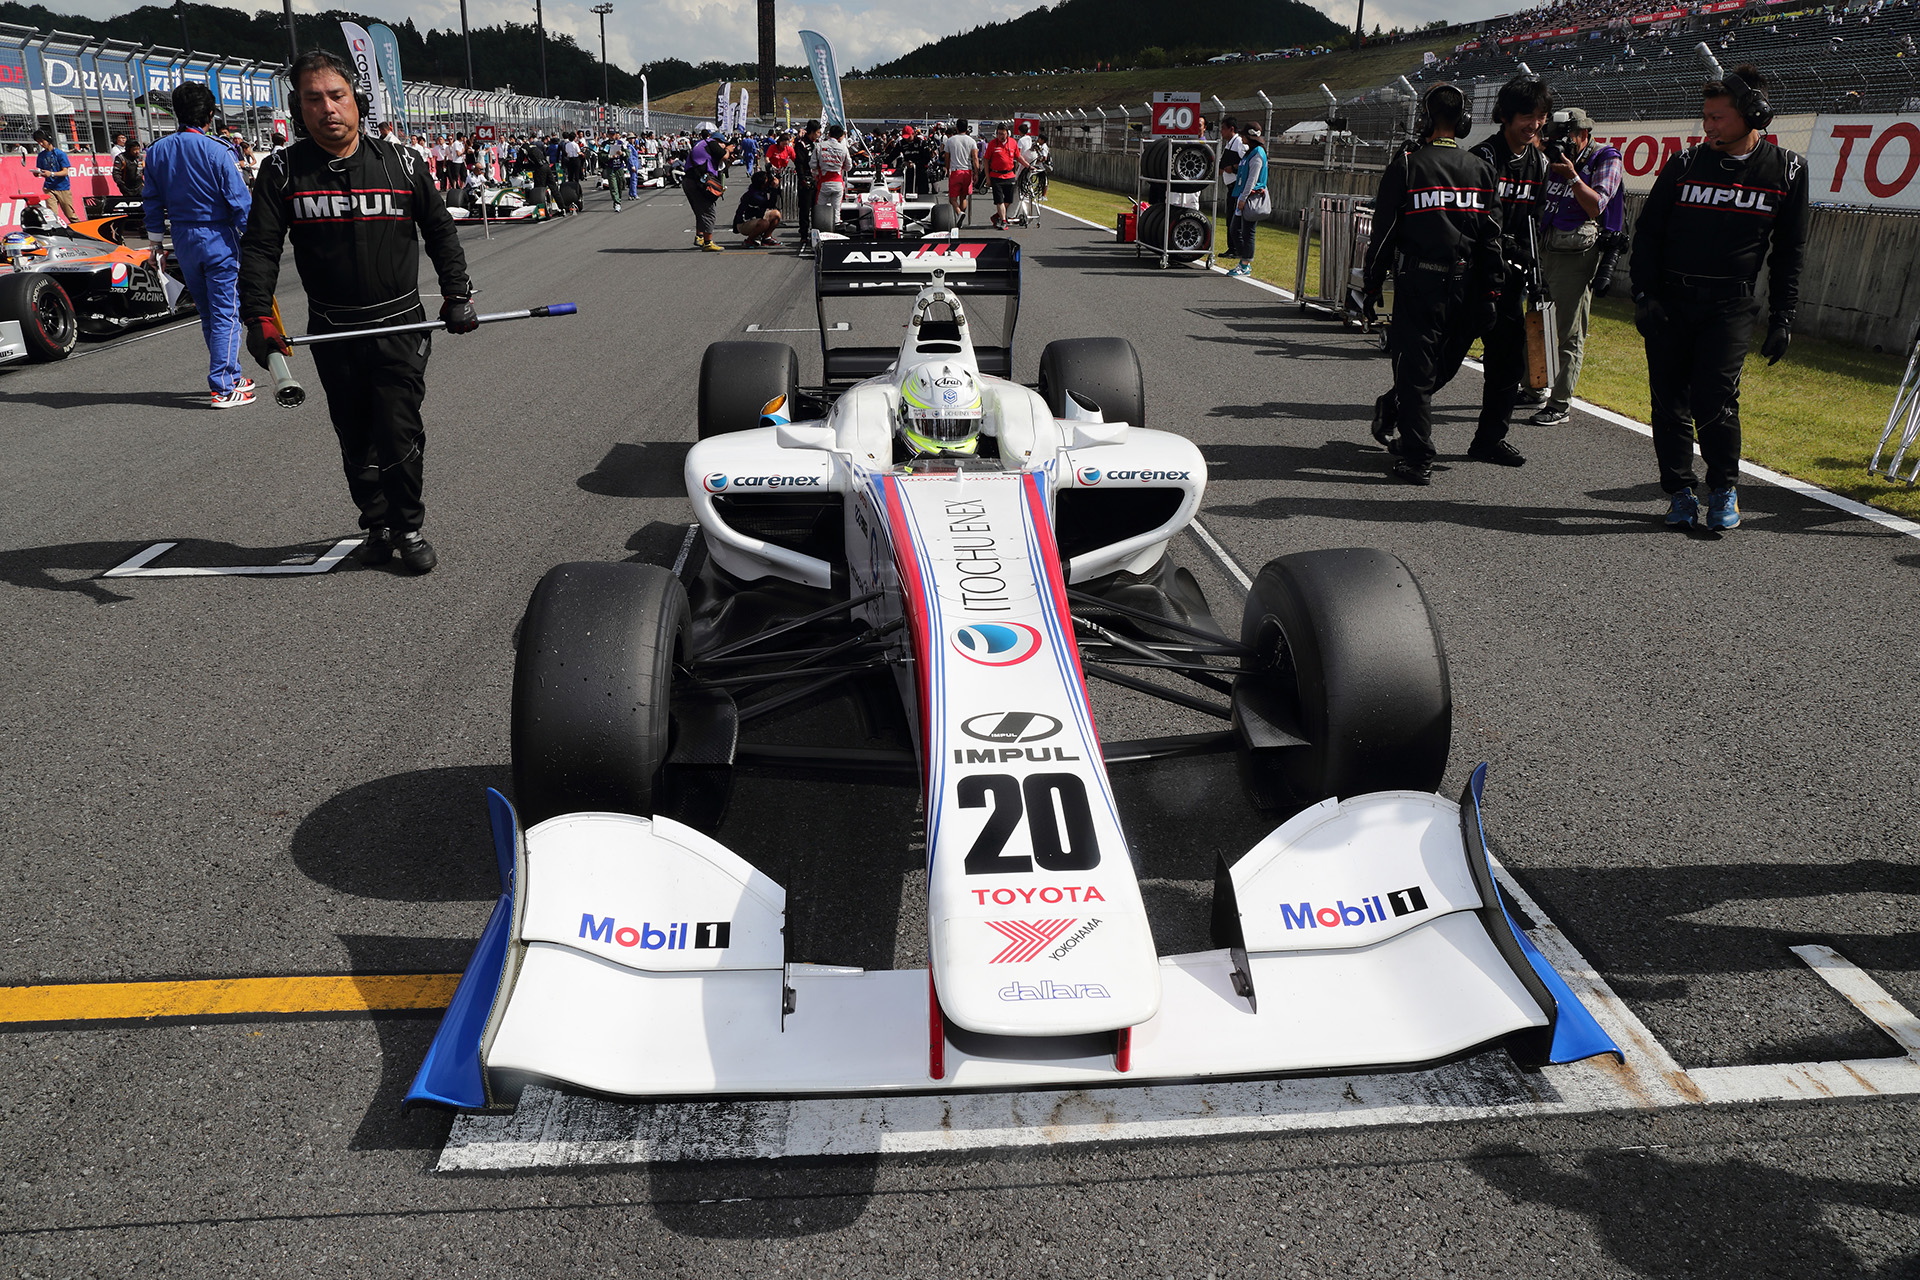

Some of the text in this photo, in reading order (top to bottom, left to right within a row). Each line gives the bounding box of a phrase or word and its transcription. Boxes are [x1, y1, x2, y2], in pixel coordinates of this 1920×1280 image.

[1159, 106, 1194, 130] 40
[478, 128, 493, 138] 64
[293, 194, 404, 219] IMPUL
[1413, 190, 1485, 210] IMPUL
[1681, 184, 1773, 212] IMPUL
[131, 292, 164, 302] RACING
[734, 474, 821, 489] carenex
[1107, 469, 1190, 483] carenex
[953, 747, 1081, 765] IMPUL
[957, 773, 1102, 876] 20
[971, 886, 1107, 906] TOYOTA
[1280, 896, 1387, 930] Mobil
[579, 913, 688, 951] Mobil
[1048, 917, 1104, 962] YOKOHAMA
[998, 980, 1111, 1002] dallara
